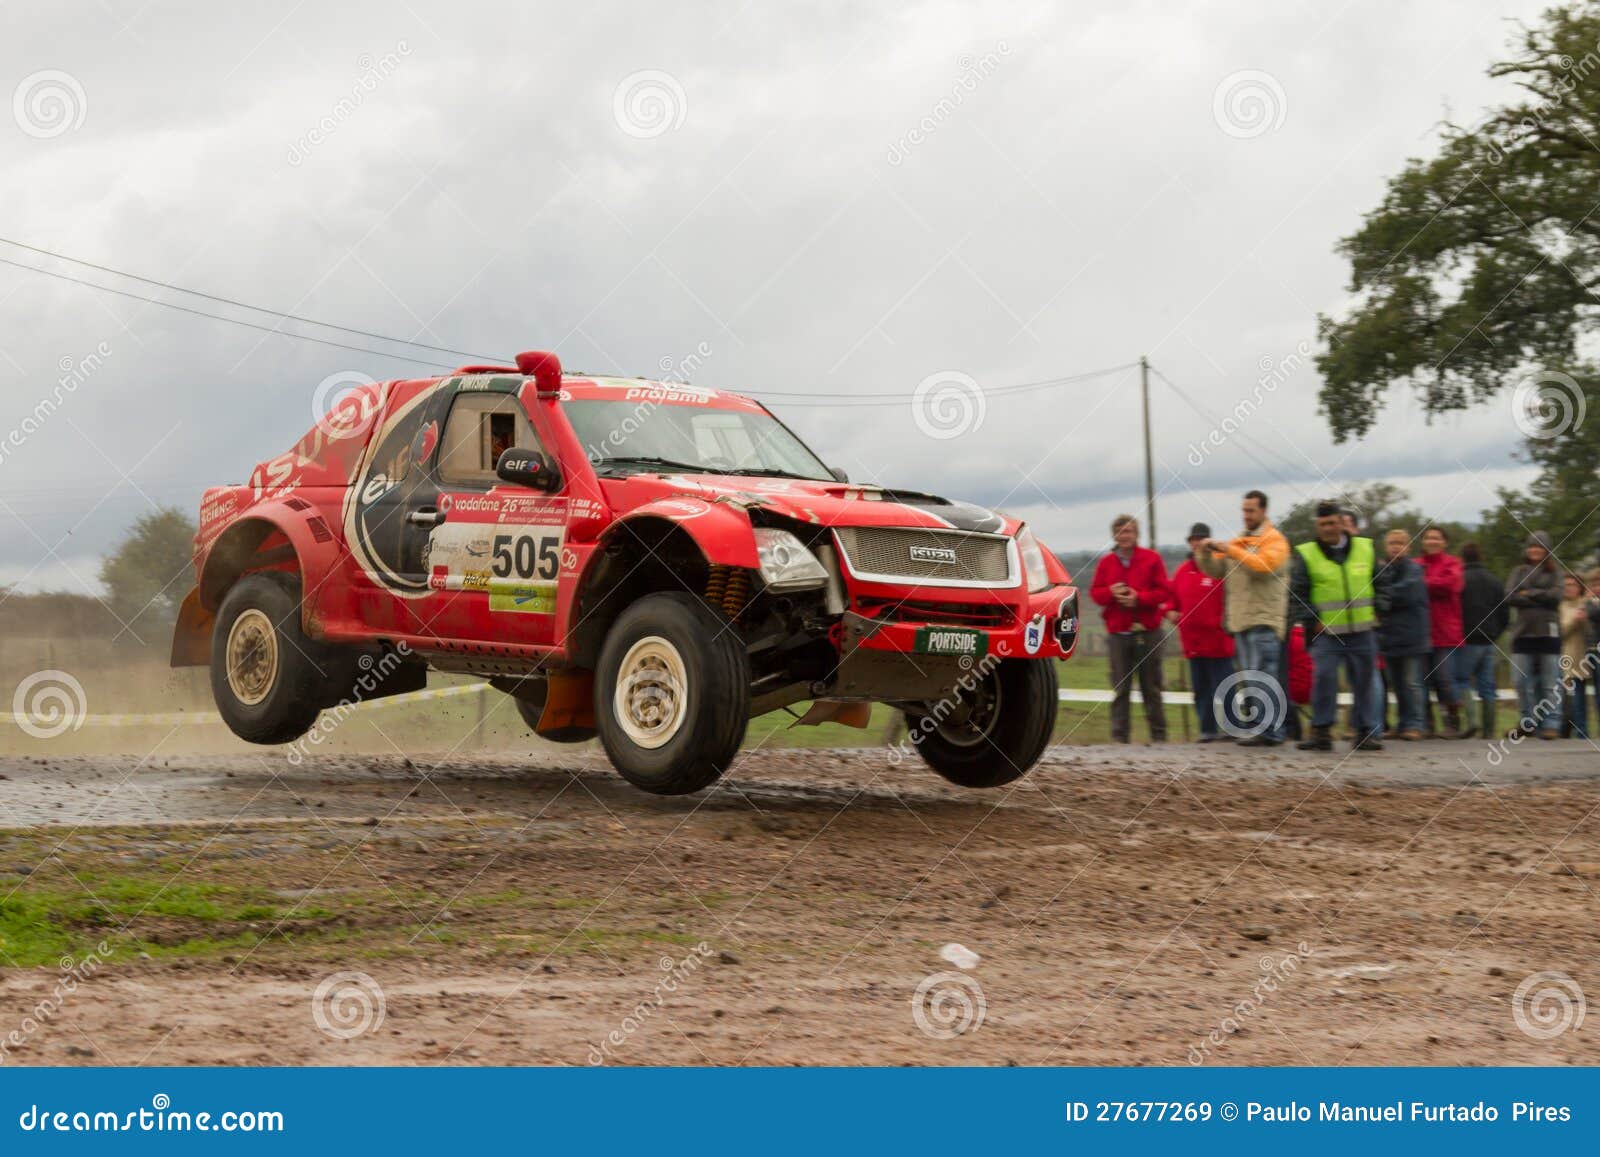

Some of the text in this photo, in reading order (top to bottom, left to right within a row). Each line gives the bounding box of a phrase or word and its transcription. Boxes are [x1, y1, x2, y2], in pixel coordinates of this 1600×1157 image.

[504, 459, 528, 471] elf
[455, 498, 500, 512] vodafone
[492, 534, 559, 580] 505
[913, 549, 954, 560] ISUZU
[928, 632, 977, 652] PORTSIDE
